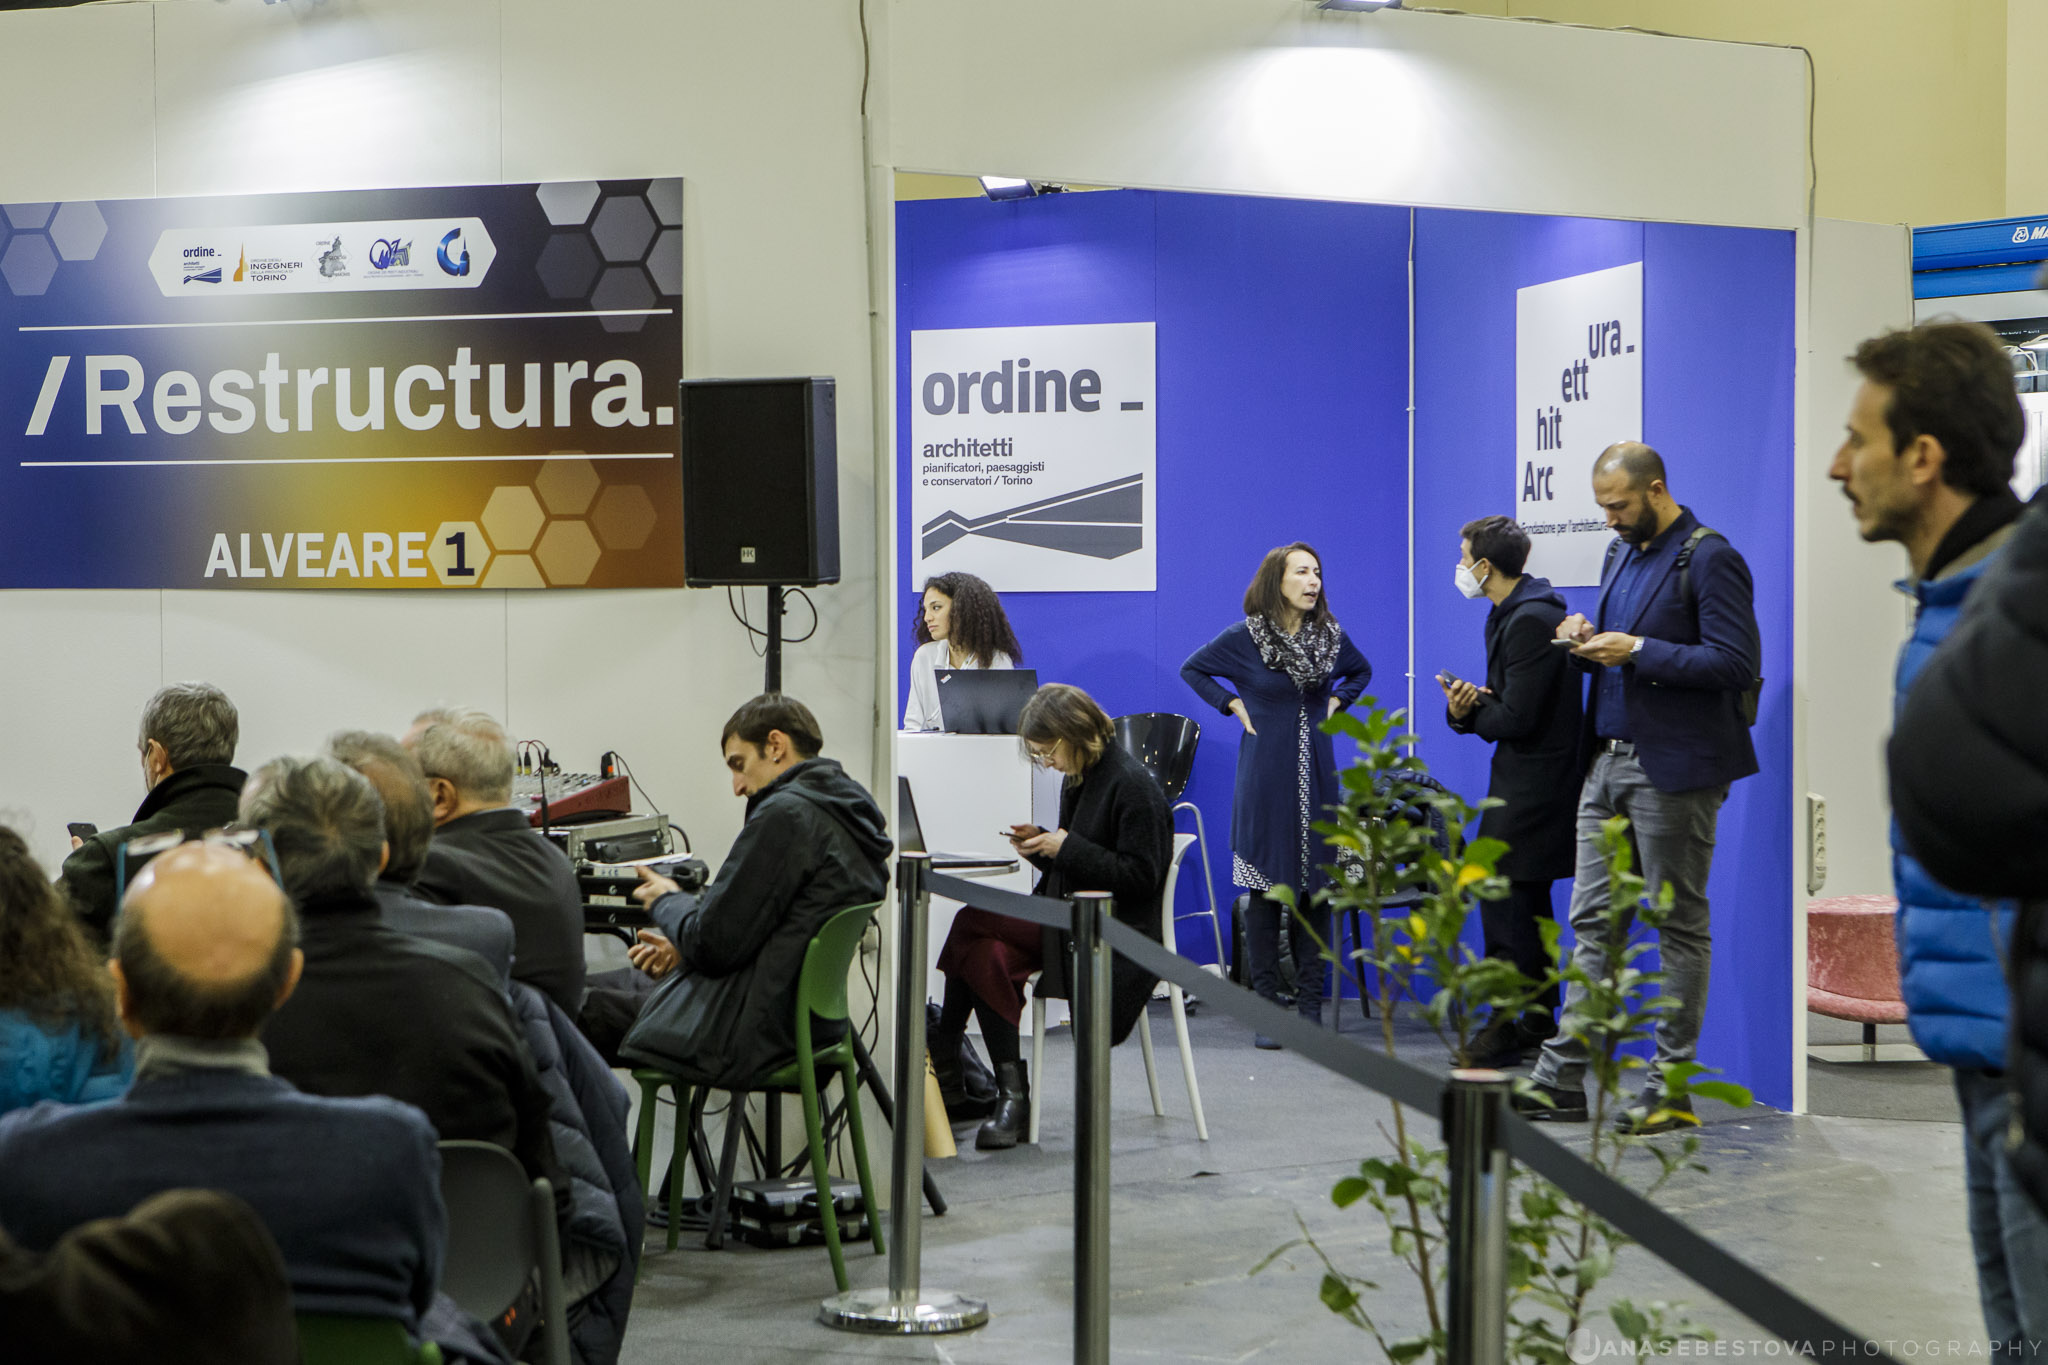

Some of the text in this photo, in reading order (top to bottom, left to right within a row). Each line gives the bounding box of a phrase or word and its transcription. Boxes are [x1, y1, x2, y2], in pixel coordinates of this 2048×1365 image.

[183, 246, 215, 258] ordine
[250, 262, 303, 270] INGEGNERI
[250, 274, 287, 282] TORINO
[922, 358, 1102, 416] ordine
[1562, 358, 1589, 403] ett
[1537, 406, 1562, 451] hit
[923, 437, 1014, 458] architetti
[922, 461, 1045, 476] pianificatori, paesaggisti
[931, 476, 993, 486] conservatori
[1002, 475, 1034, 486] Torino
[1523, 461, 1554, 502] Arc
[1557, 524, 1567, 537] per
[204, 531, 476, 579] ALVEARE 1
